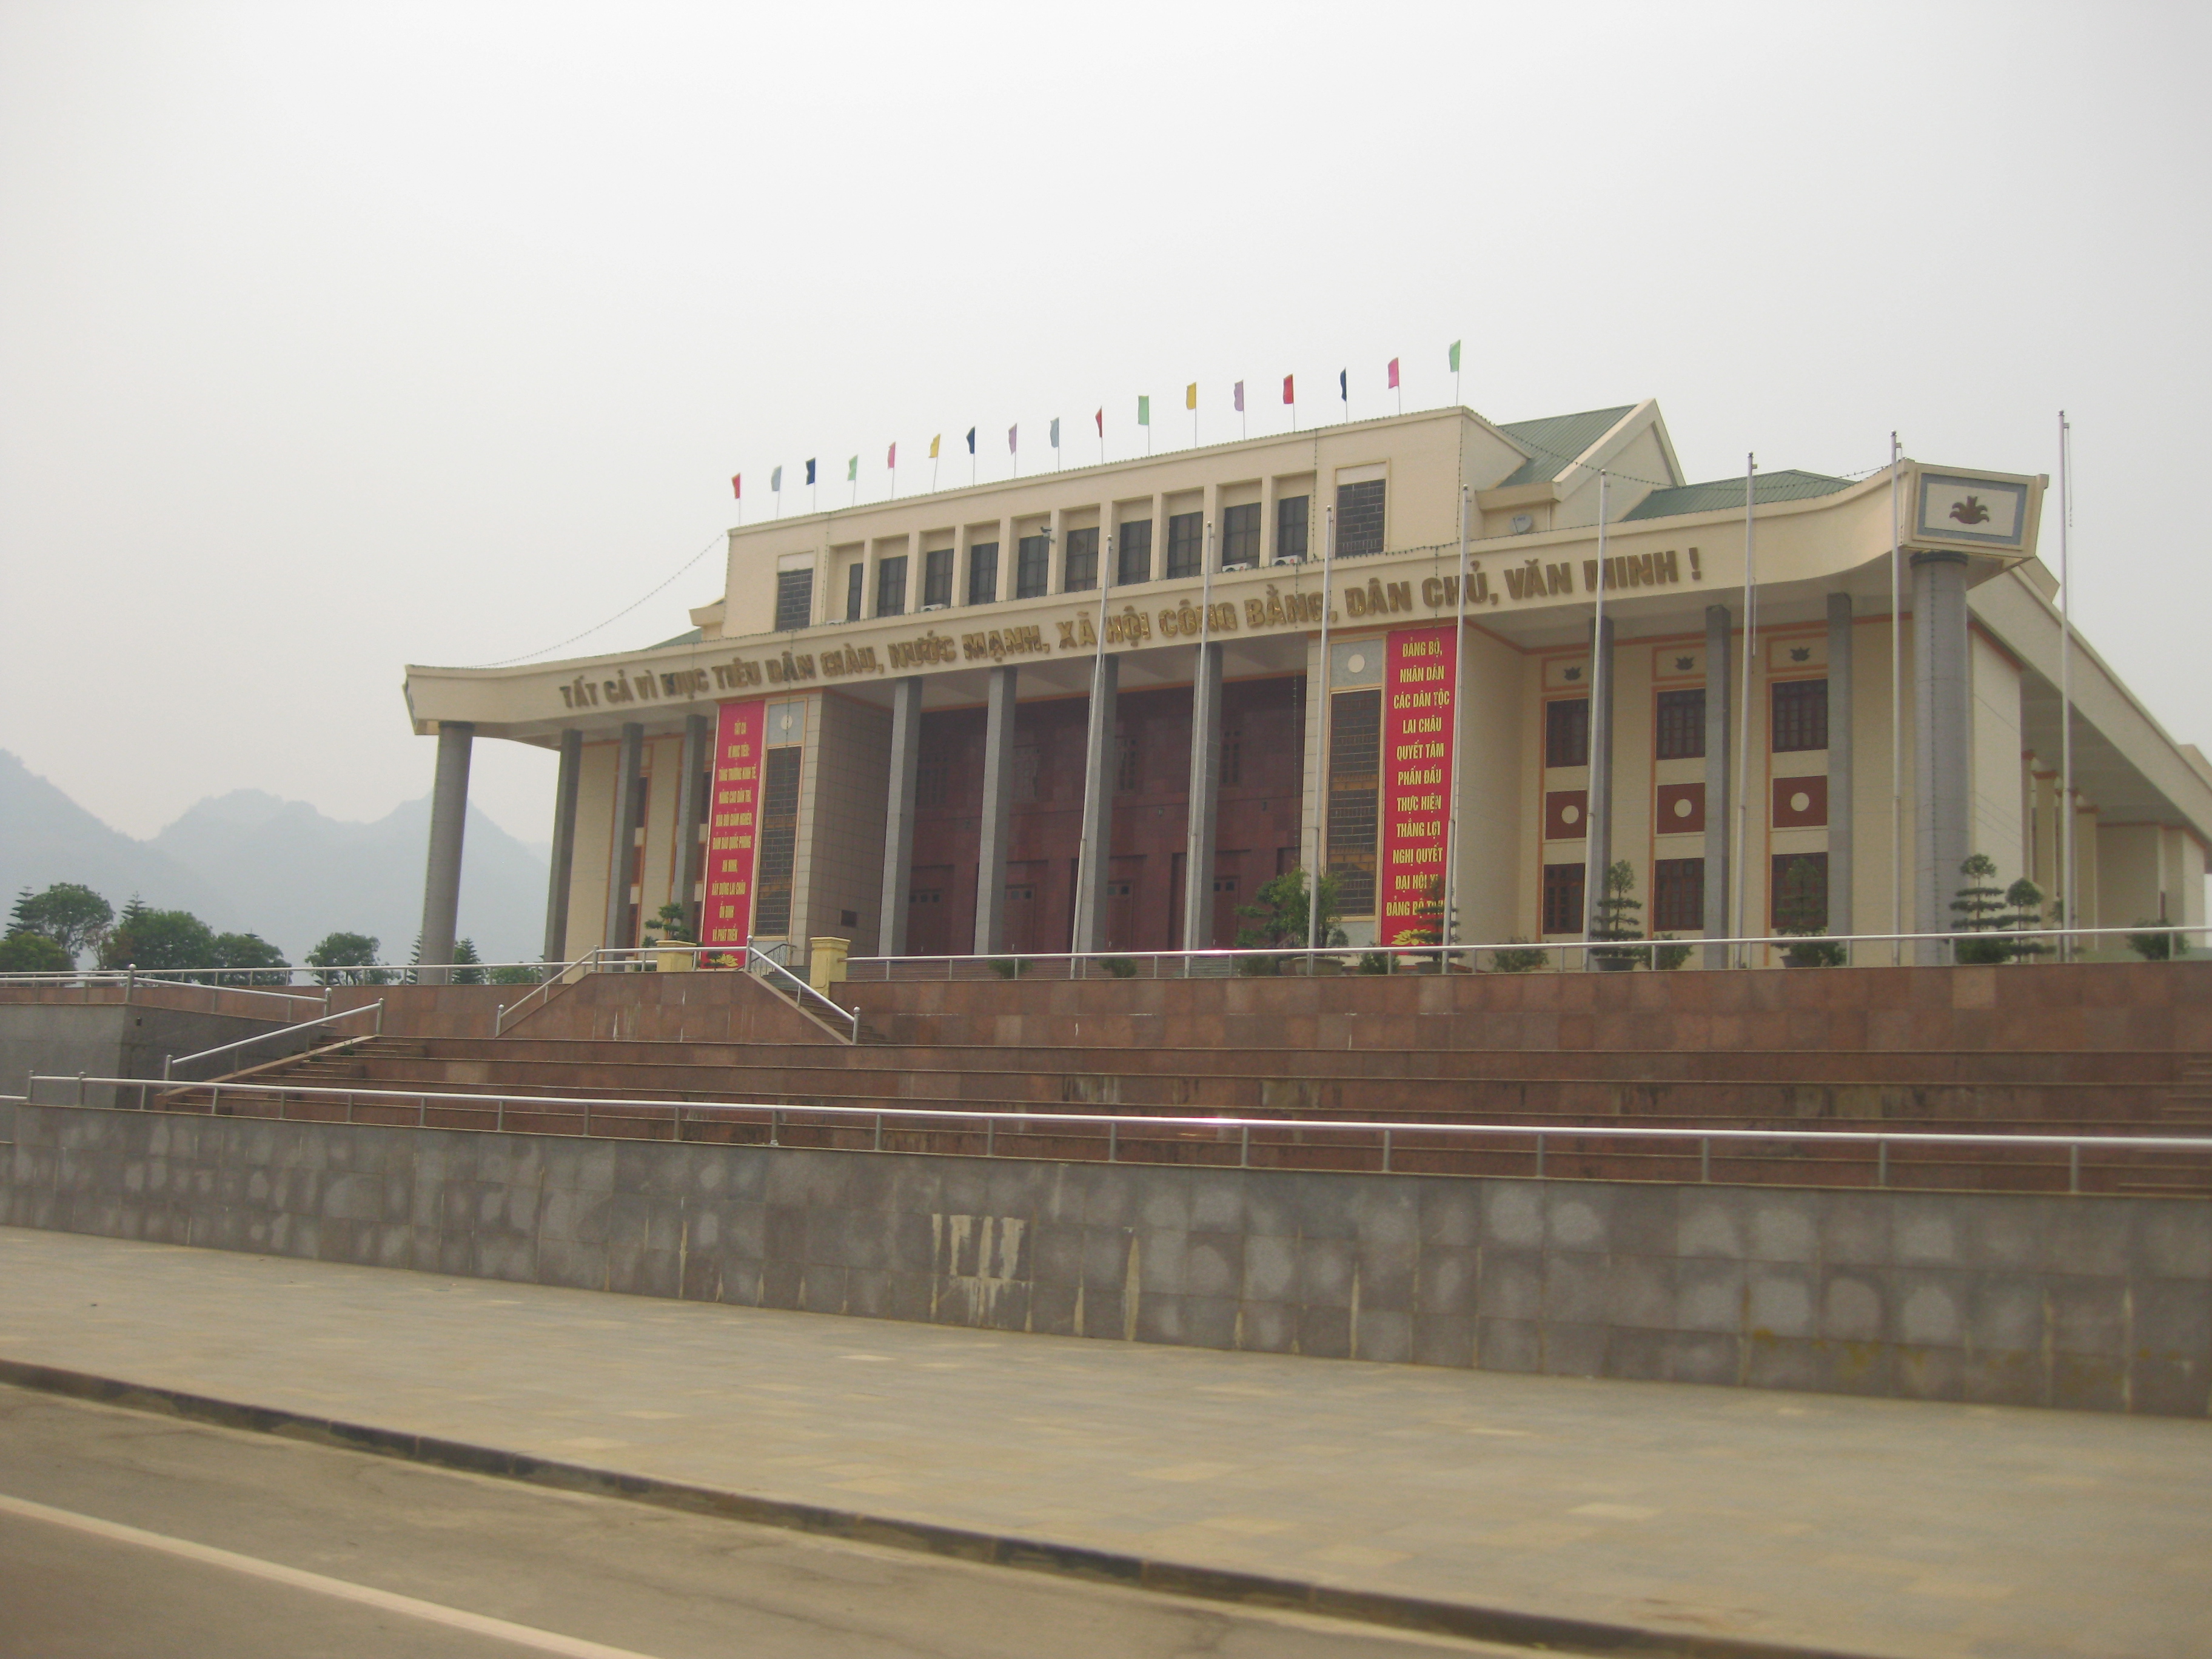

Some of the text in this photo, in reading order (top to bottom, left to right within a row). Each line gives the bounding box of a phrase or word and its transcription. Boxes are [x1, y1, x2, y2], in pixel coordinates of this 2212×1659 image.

[559, 547, 1701, 708] TẤT CẢ VÌ MỤC TIÊU DÂN GIÀU, NƯỚC MẠNH, XÃ HỘI CÔNG BẰNG, DÂN CHỦ, VĂN MINH !
[1402, 637, 1443, 657] ĐẢNG BỘ,
[1400, 663, 1444, 683] NHÂN DÂN
[1393, 688, 1450, 709] CÁC DÂN TỘC
[1403, 715, 1442, 734] LAI CHÂU
[1396, 739, 1444, 761] QUYẾT TÂM
[1398, 763, 1442, 785] PHẤN ĐẤU
[1396, 793, 1442, 814] THỰC HIỆN
[1396, 818, 1441, 839] THẮNG LỢI
[1393, 842, 1443, 866] NGHỊ QUYẾT
[1395, 875, 1410, 893] ĐẠI
[1412, 871, 1427, 892] HỘI
[1386, 896, 1410, 916] ĐẢNG
